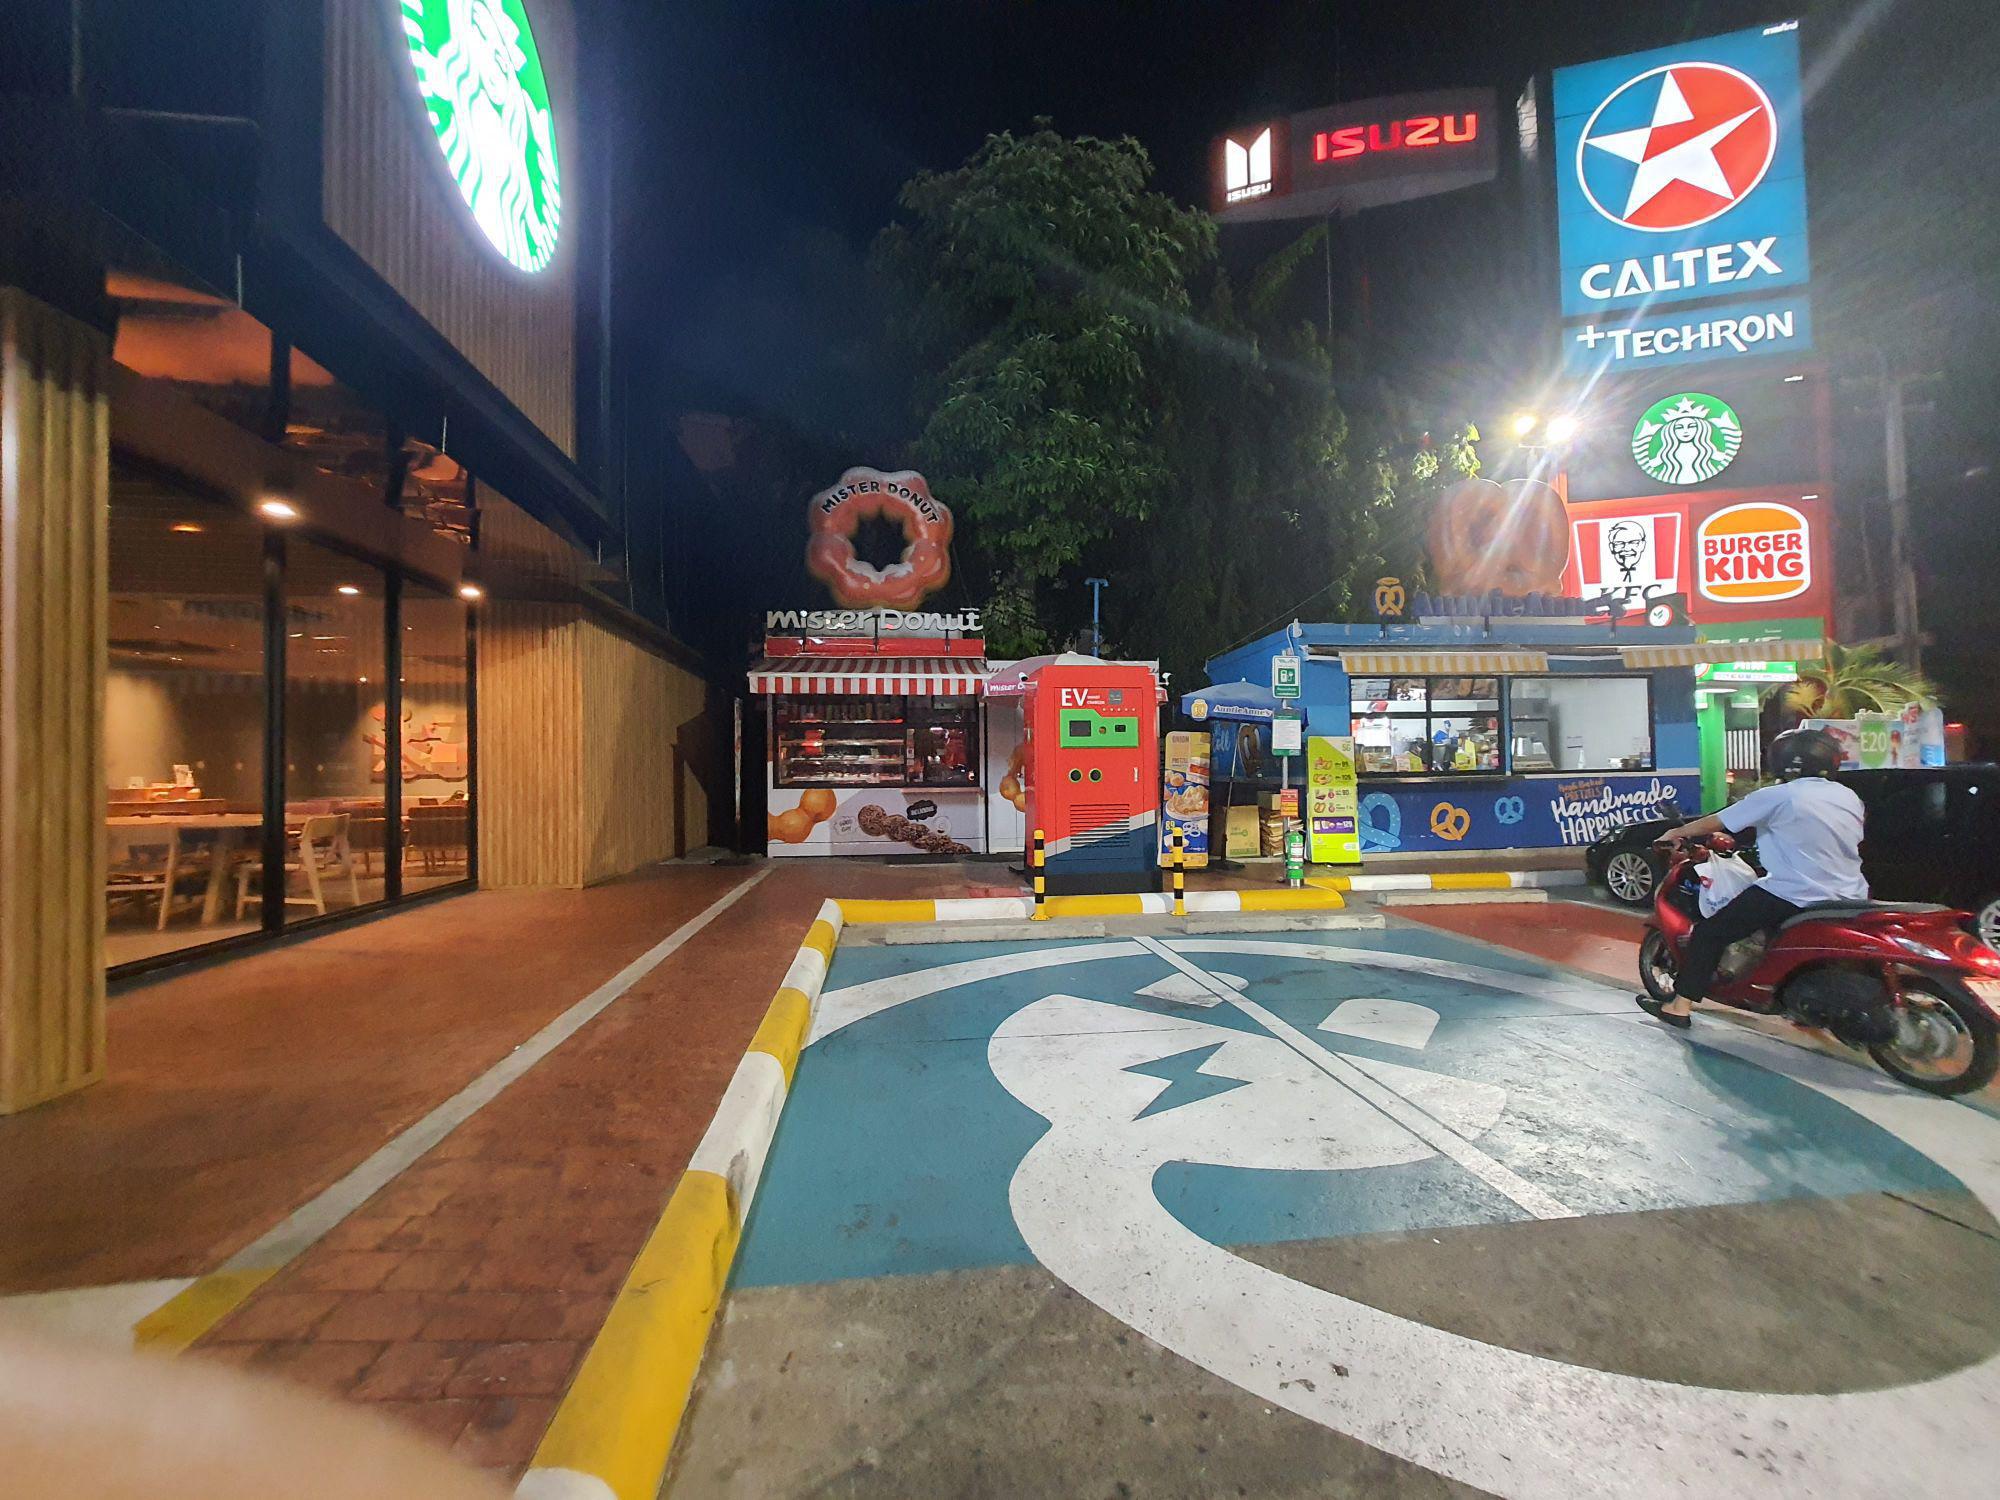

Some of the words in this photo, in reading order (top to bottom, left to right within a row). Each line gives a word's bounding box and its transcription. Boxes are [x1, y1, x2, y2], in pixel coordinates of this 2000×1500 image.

[1315, 114, 1477, 162] ISUZU
[1227, 182, 1272, 202] ISUZU
[1579, 236, 1783, 300] CALTEX
[820, 481, 880, 513] MISTER
[888, 482, 938, 524] DONUT
[1704, 532, 1803, 557] BURGER
[1705, 551, 1804, 583] KING
[880, 608, 984, 631] Donut
[1061, 688, 1088, 706] EV
[1860, 731, 1887, 753] E20
[1551, 777, 1677, 823] Handmade
